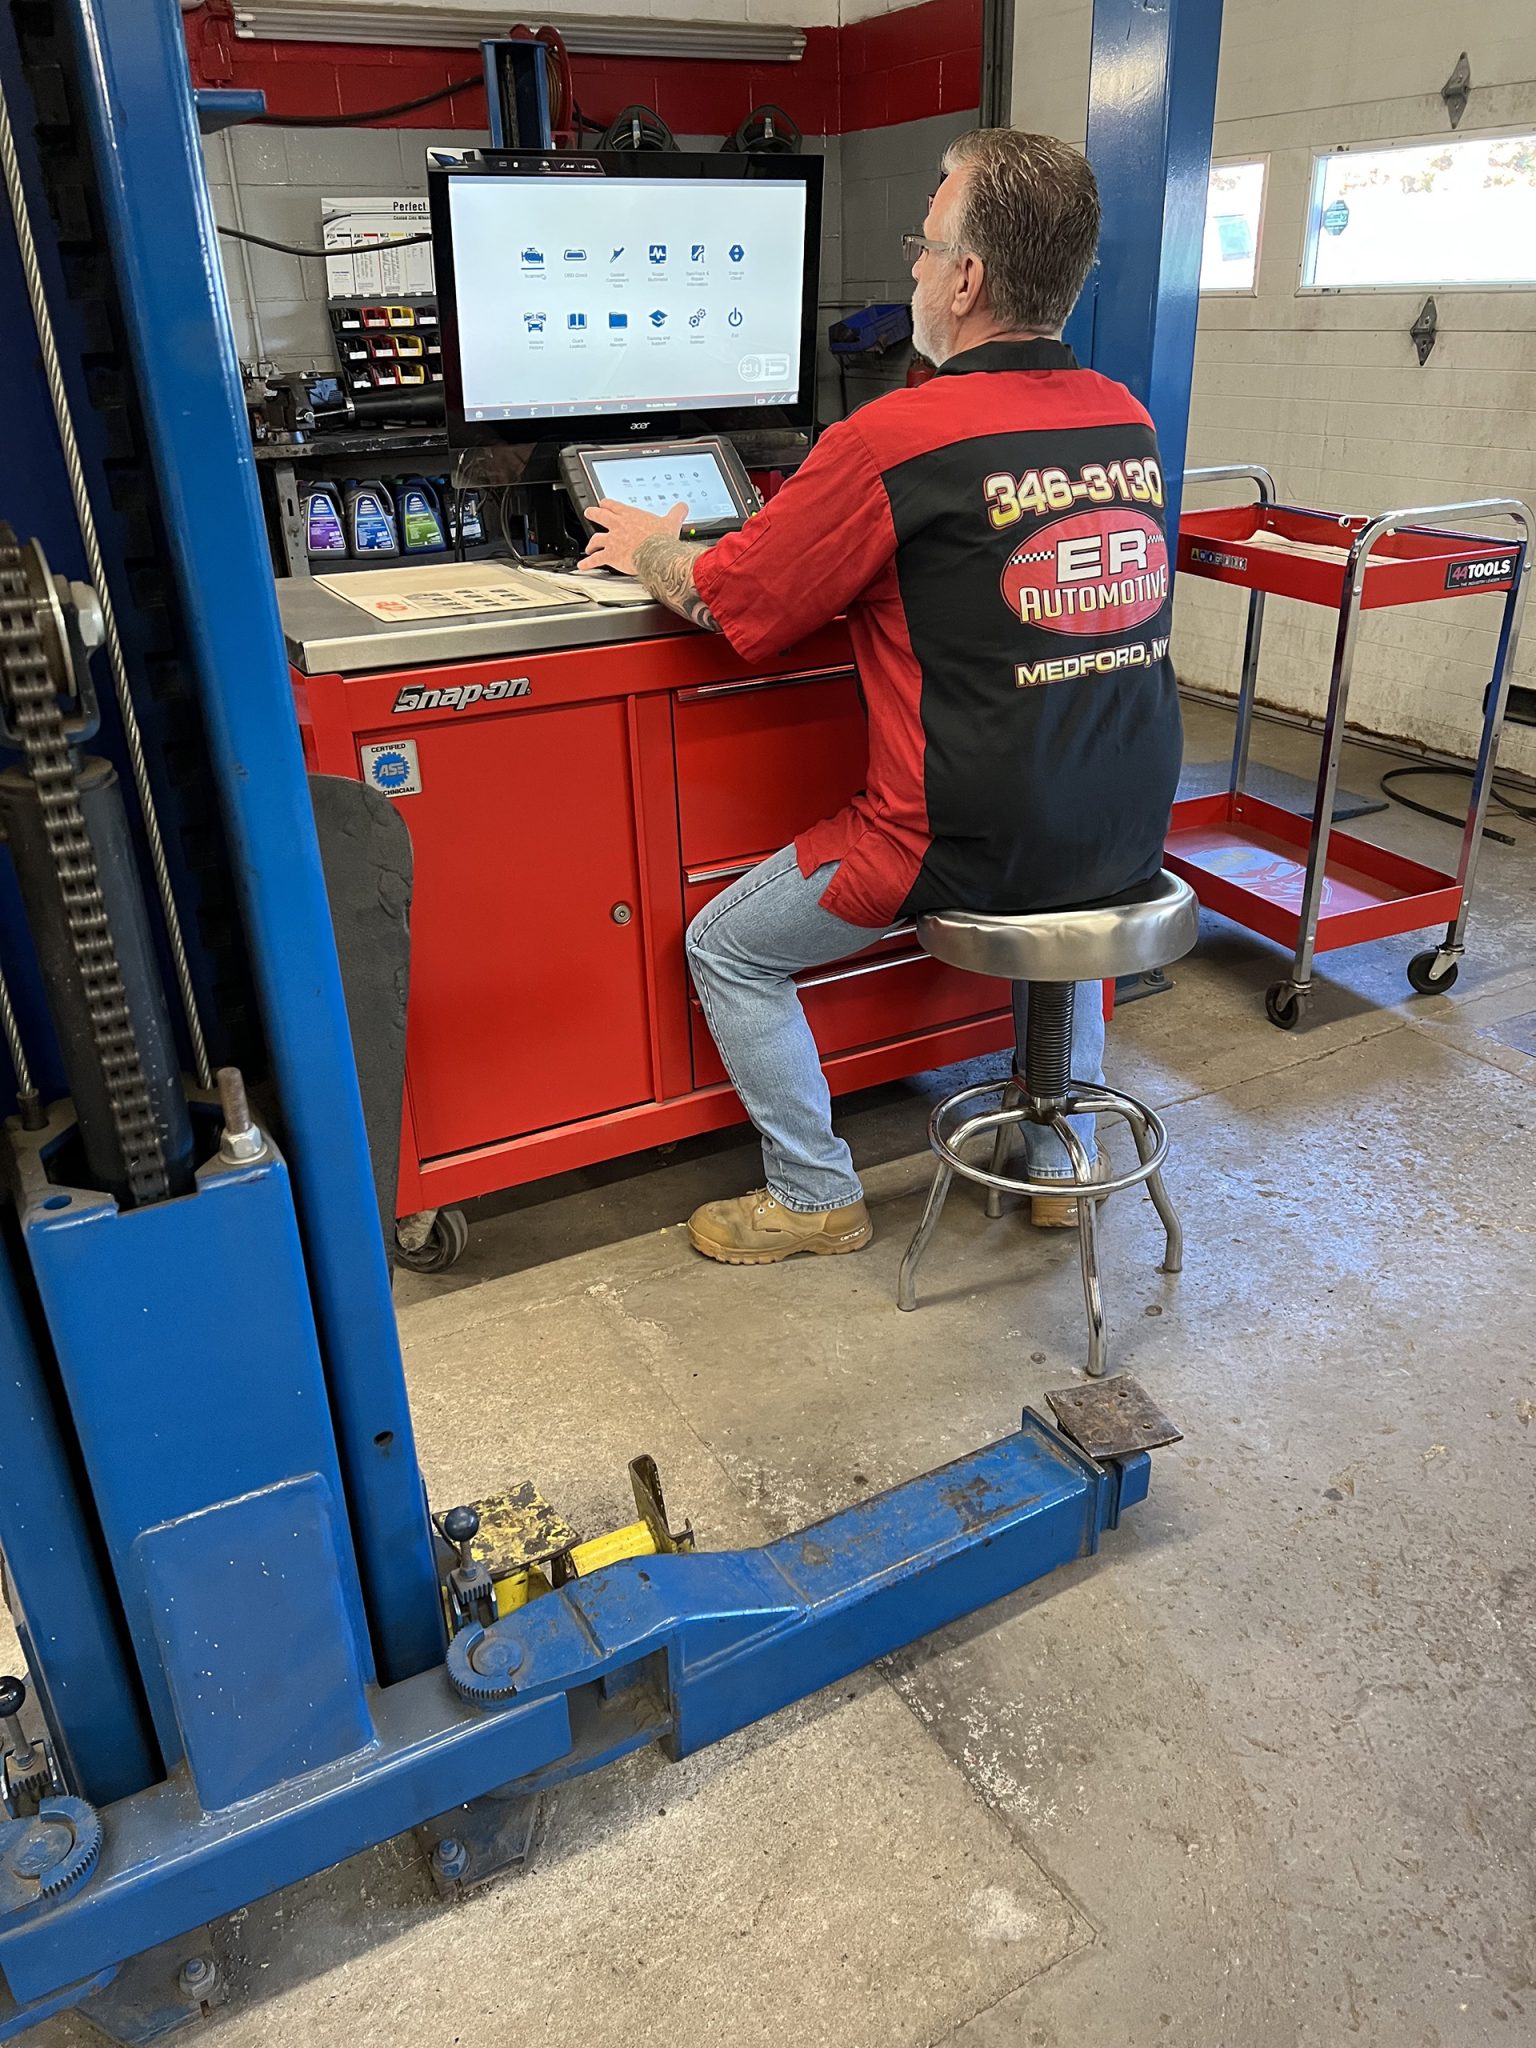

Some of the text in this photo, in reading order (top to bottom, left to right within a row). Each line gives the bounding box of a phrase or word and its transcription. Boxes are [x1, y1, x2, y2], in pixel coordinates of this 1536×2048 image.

[393, 201, 426, 211] Perfect
[630, 421, 651, 430] acer
[984, 457, 1164, 529] 346-3130
[1056, 529, 1148, 583] ER
[1019, 564, 1168, 624] AUTOMOTIVE
[1015, 636, 1170, 688] MEDFORD, NY
[392, 677, 531, 713] Snap-on
[371, 743, 406, 753] CERTIFIED
[378, 762, 405, 777] ASE
[383, 786, 415, 796] CHNICIAN
